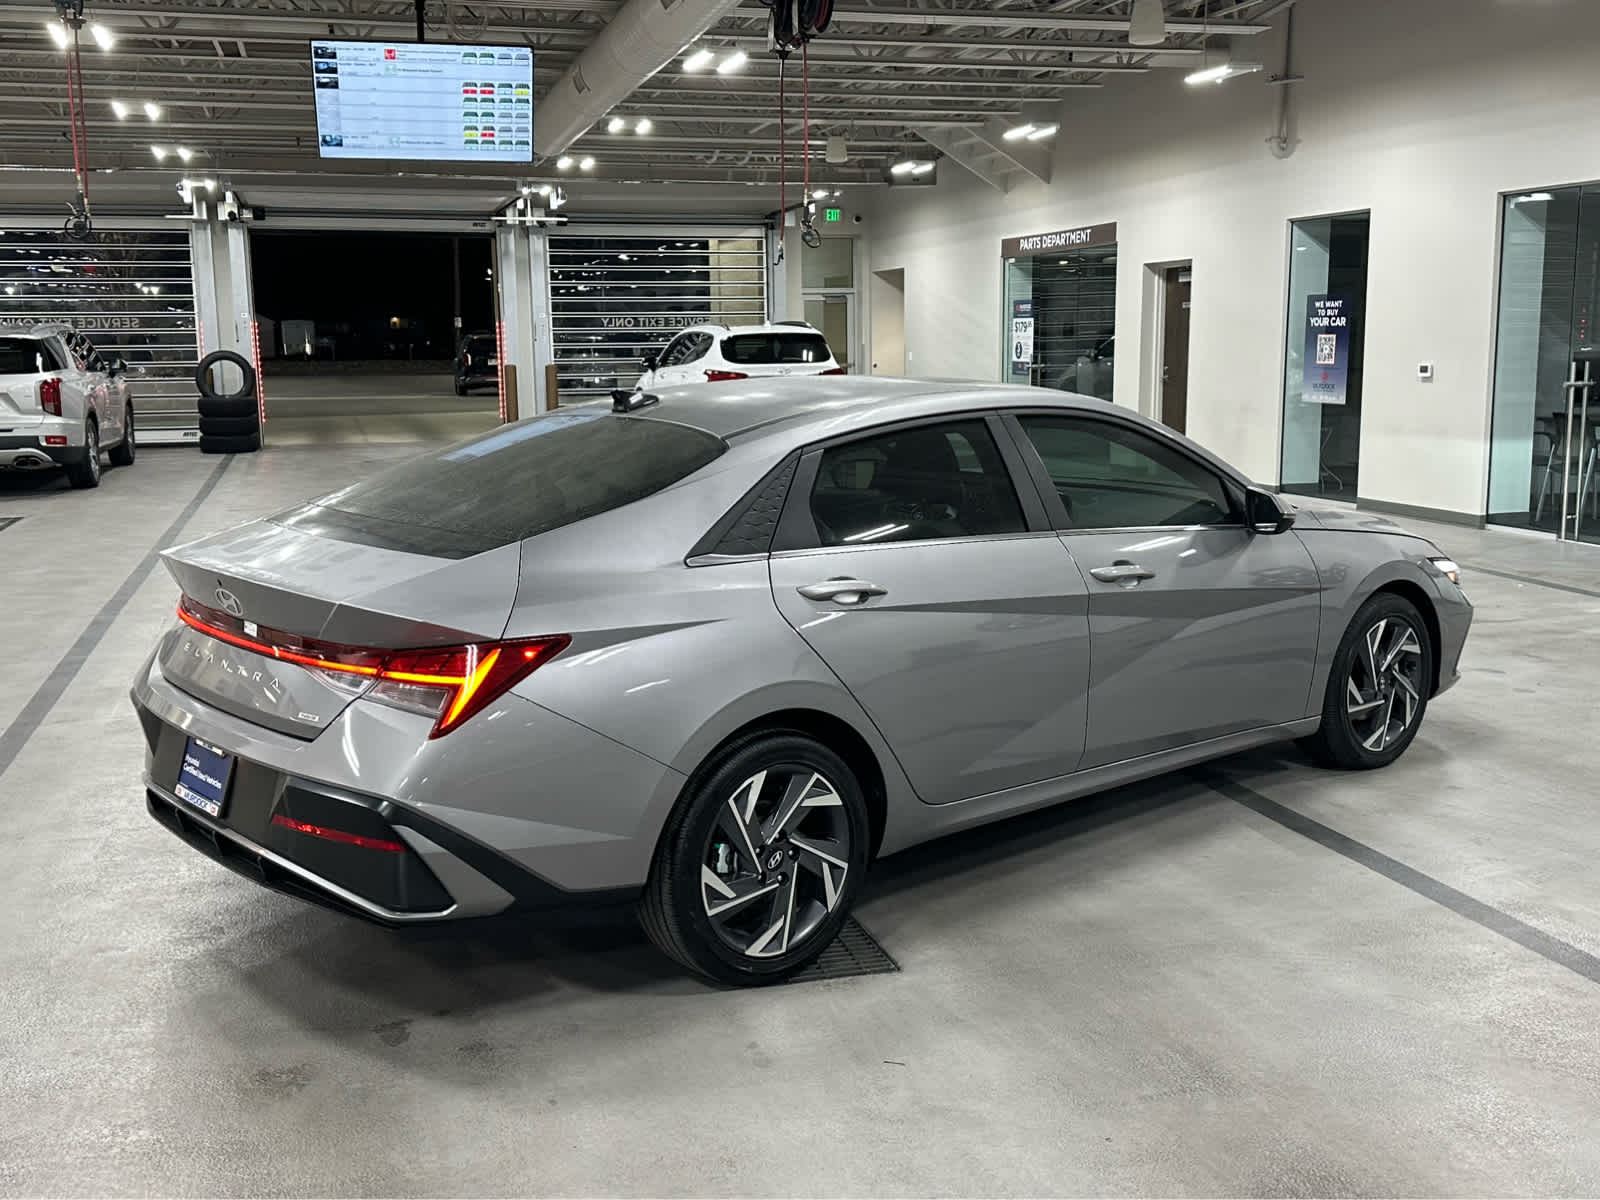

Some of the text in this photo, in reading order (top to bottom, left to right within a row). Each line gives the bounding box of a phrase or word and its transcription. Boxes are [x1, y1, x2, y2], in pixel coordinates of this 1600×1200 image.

[826, 208, 841, 222] EXIT
[1019, 229, 1091, 251] PARTS DEPARTMENT
[1325, 300, 1343, 308] WANT
[1309, 316, 1347, 327] YOUR CAR
[184, 642, 280, 689] ELANTRA
